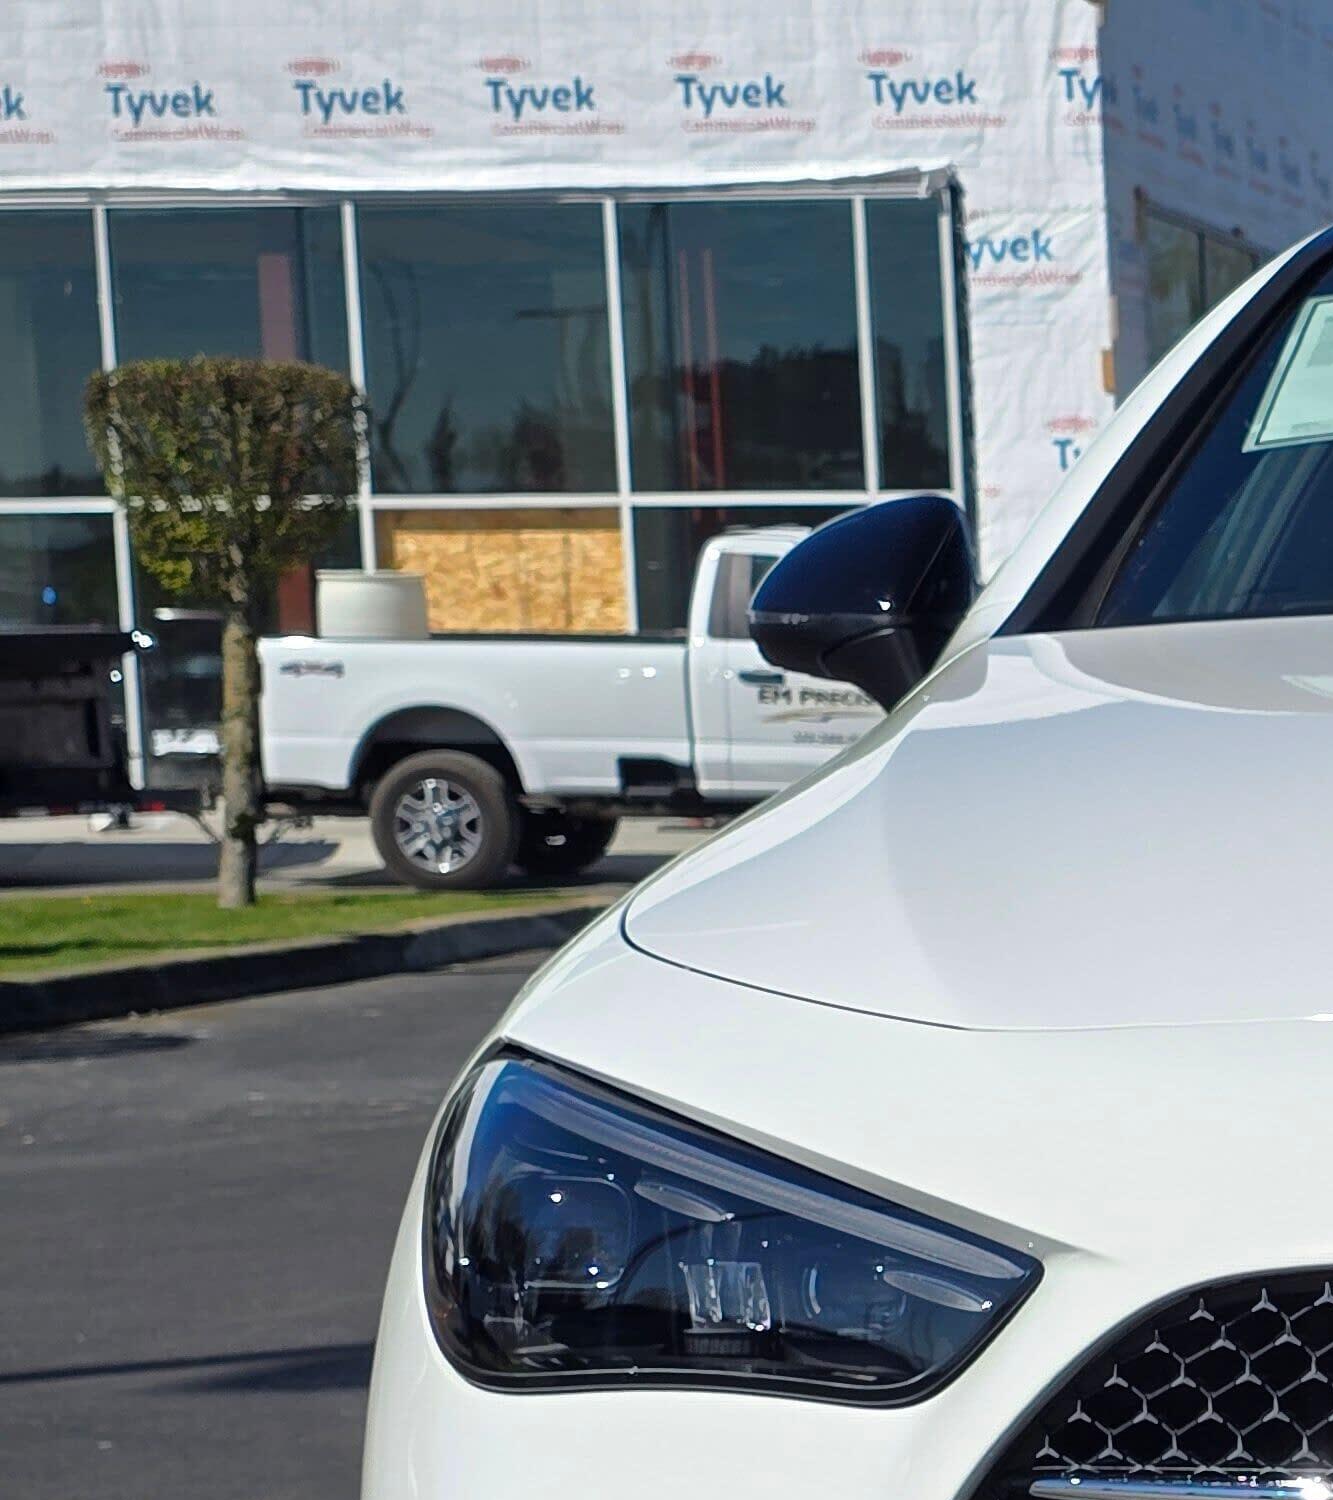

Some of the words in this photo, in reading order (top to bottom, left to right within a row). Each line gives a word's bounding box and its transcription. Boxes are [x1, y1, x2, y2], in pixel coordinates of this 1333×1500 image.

[104, 81, 217, 127] Tyvek
[293, 78, 405, 124] Tyvek
[484, 75, 595, 122] Tyvek
[674, 72, 788, 118] Tyvek
[867, 69, 978, 113] Tyvek
[965, 228, 1054, 271] yvek
